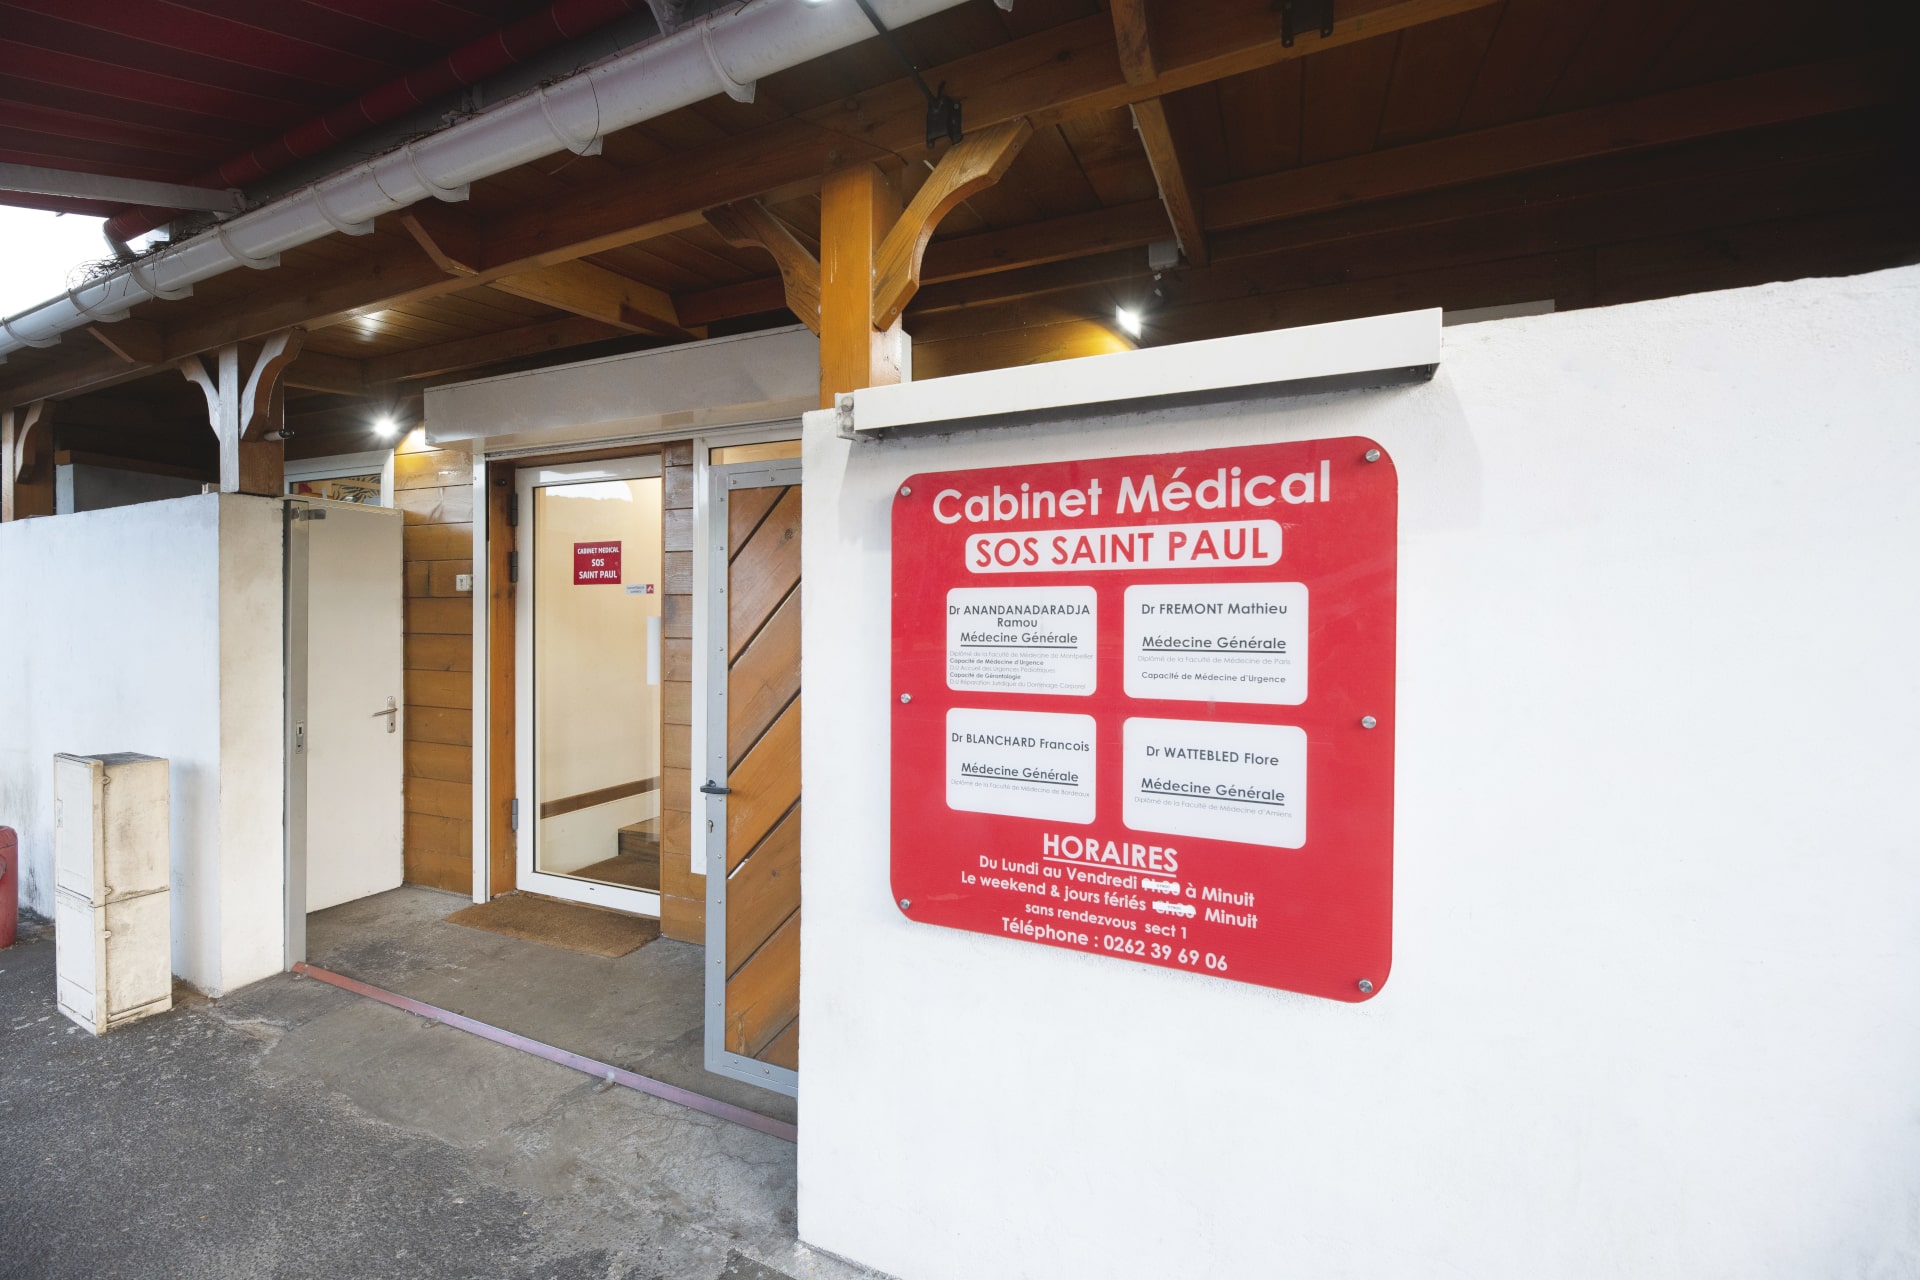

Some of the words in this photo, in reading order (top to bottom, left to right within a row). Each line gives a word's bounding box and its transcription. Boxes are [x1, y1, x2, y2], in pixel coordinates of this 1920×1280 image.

[933, 483, 1103, 525] Cabinet
[1116, 460, 1331, 515] Médical
[975, 537, 1039, 568] SOS
[1051, 532, 1155, 565] SAINT
[1168, 527, 1268, 561] PAUL
[591, 558, 604, 567] SOS
[579, 571, 598, 579] SAINT
[599, 570, 617, 578] PAUL
[949, 605, 960, 615] Dr
[964, 604, 1091, 615] ANANDANADARADJA
[1141, 604, 1155, 614] Dr
[1159, 603, 1223, 615] FREMONT
[1228, 602, 1287, 614] Mathieu
[997, 618, 1037, 628] Ramou
[960, 631, 1018, 643] Médecine
[1021, 633, 1078, 644] Générale
[1142, 635, 1212, 648] Médecine
[1217, 636, 1286, 649] Générale
[950, 658, 975, 666] Capacité
[1186, 655, 1211, 663] Faculté
[1224, 656, 1260, 664] Médecine
[950, 672, 975, 680] Capacité
[1141, 672, 1179, 682] Capacité
[1194, 673, 1237, 682] Médecine
[951, 733, 963, 743] Dr
[966, 734, 1036, 748] BLANCHARD
[1040, 739, 1090, 752] Francois
[1146, 746, 1159, 756] Dr
[1164, 747, 1239, 763] WATTEBLED
[1244, 753, 1279, 766] Flore
[961, 762, 1019, 777] Médecine
[1022, 768, 1079, 782] Générale
[1141, 777, 1211, 794] Médecine
[1216, 784, 1285, 801] Générale
[1043, 832, 1179, 872] HORAIRES
[979, 855, 998, 869] Du
[1001, 857, 1039, 875] Lundi
[1042, 865, 1062, 878] au
[1066, 866, 1137, 890] Vendredi
[1185, 883, 1197, 899] à
[1201, 886, 1255, 908] Minuit
[961, 871, 976, 885] Le
[980, 874, 1046, 896] weekend
[1050, 884, 1060, 897] &
[1063, 885, 1100, 904] jours
[1104, 891, 1146, 911] fériés
[1204, 907, 1258, 929] Minuit
[1025, 903, 1054, 917] sans
[1057, 907, 1137, 931] rendezvous
[1144, 922, 1176, 938] sect
[1180, 926, 1187, 939] 1
[1002, 917, 1089, 947] Téléphone
[1094, 936, 1099, 948] :
[1104, 934, 1145, 957] 0262
[1150, 943, 1172, 961] 39
[1177, 948, 1200, 966] 69
[1205, 952, 1228, 971] 06
